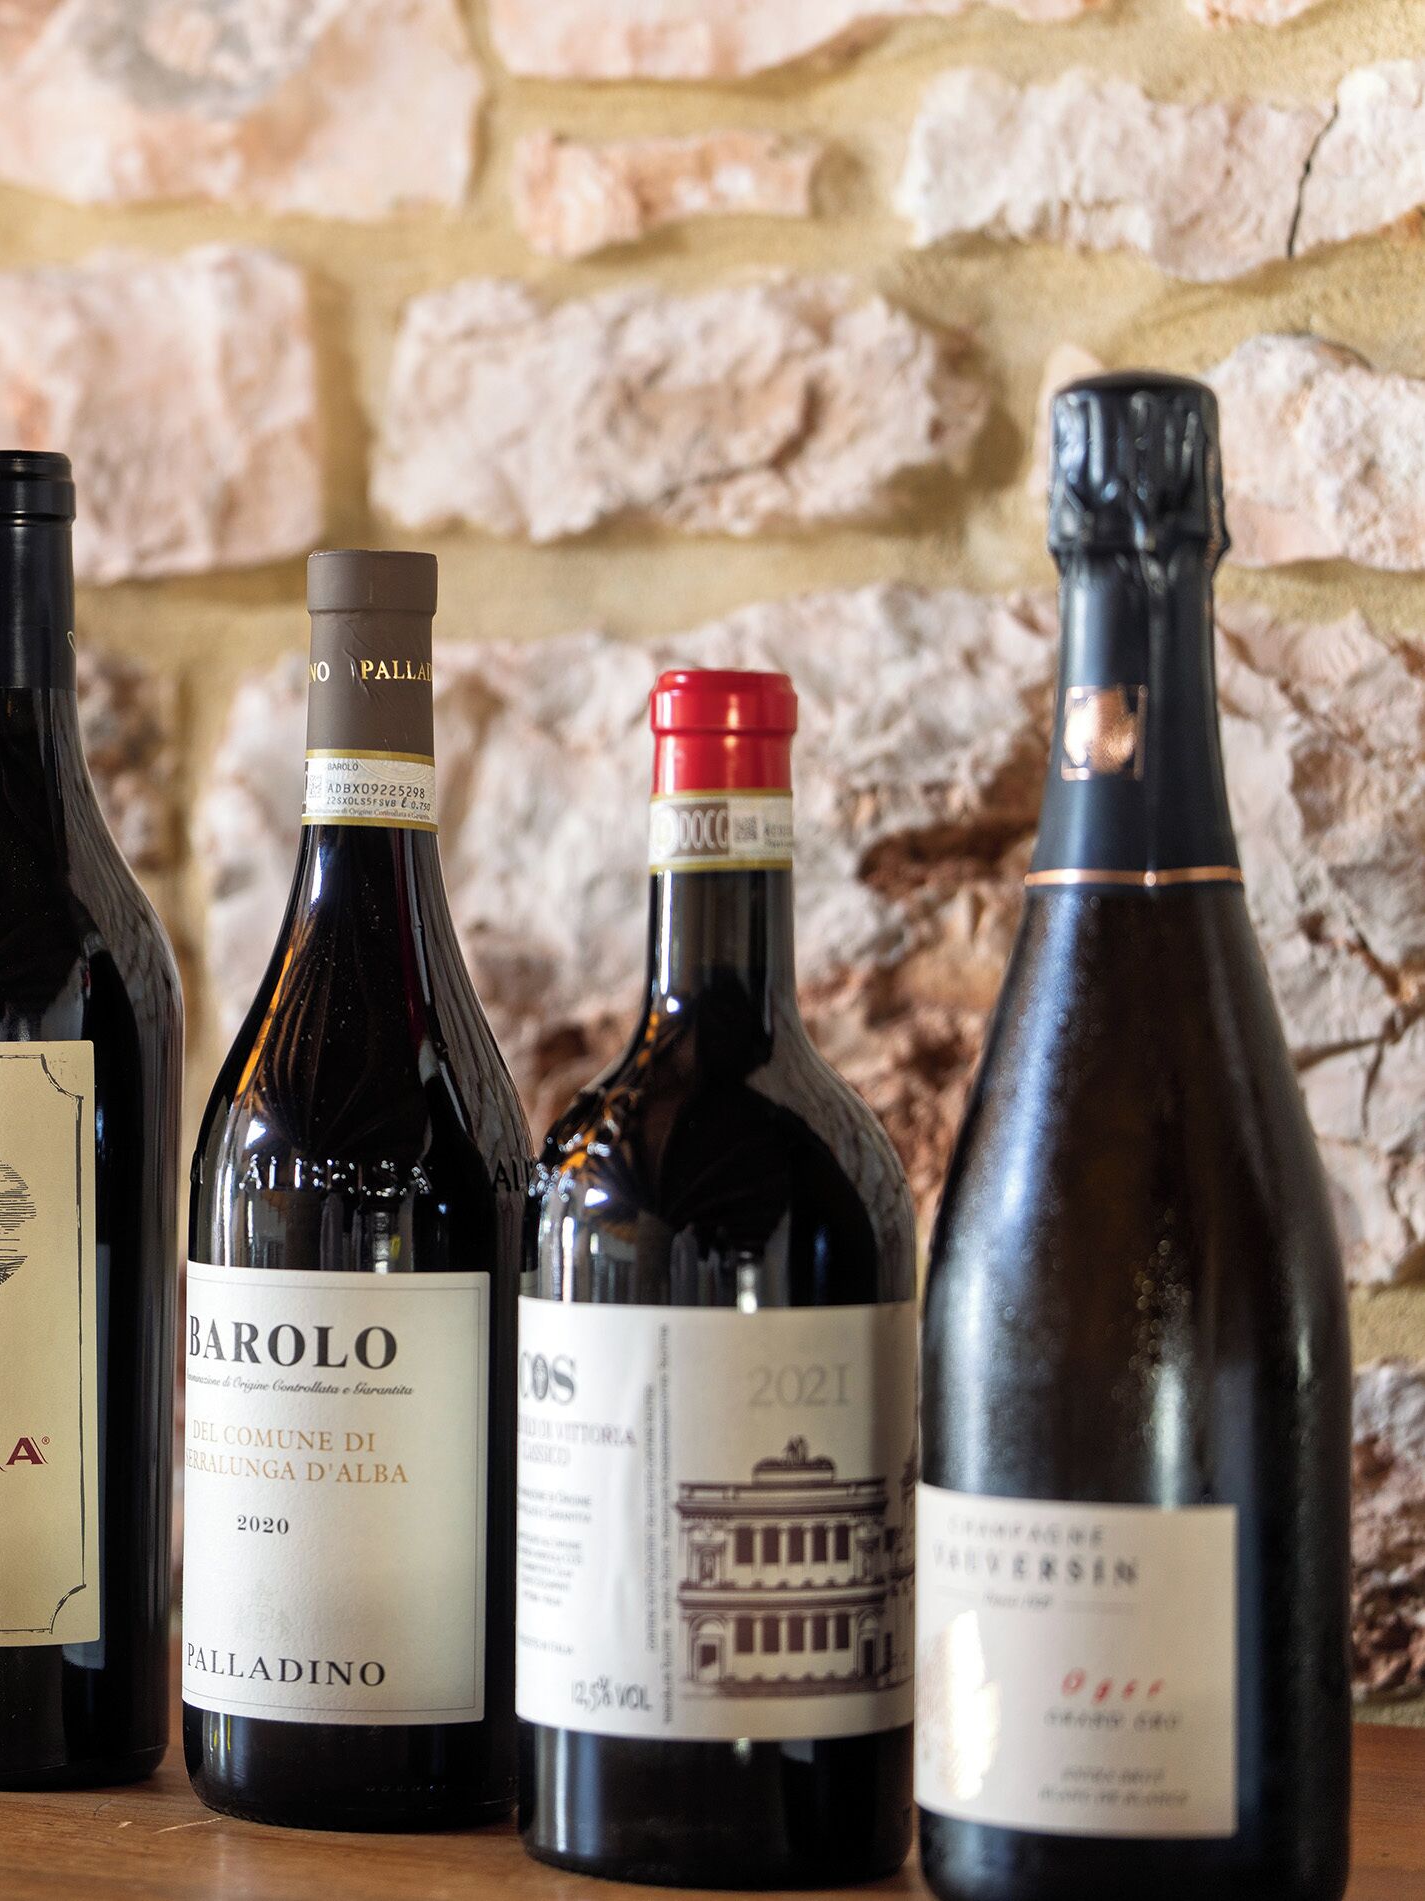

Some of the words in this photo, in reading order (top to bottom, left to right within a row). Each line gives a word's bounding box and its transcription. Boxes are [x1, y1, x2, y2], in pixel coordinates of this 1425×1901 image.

[327, 762, 359, 772] BAROLO
[189, 1315, 397, 1370] BAROLO
[233, 1376, 270, 1393] Origine
[272, 1378, 338, 1395] Controllata
[342, 1386, 350, 1395] e
[354, 1382, 414, 1396] Garantita
[747, 1362, 851, 1409] 2021
[192, 1419, 219, 1443] DEL
[223, 1425, 333, 1452] COMUNE
[344, 1432, 376, 1452] DI
[306, 1461, 409, 1484] D'ALBA
[237, 1514, 290, 1535] 2020
[186, 1641, 386, 1688] PALLADINO
[615, 1682, 653, 1712] VOL
